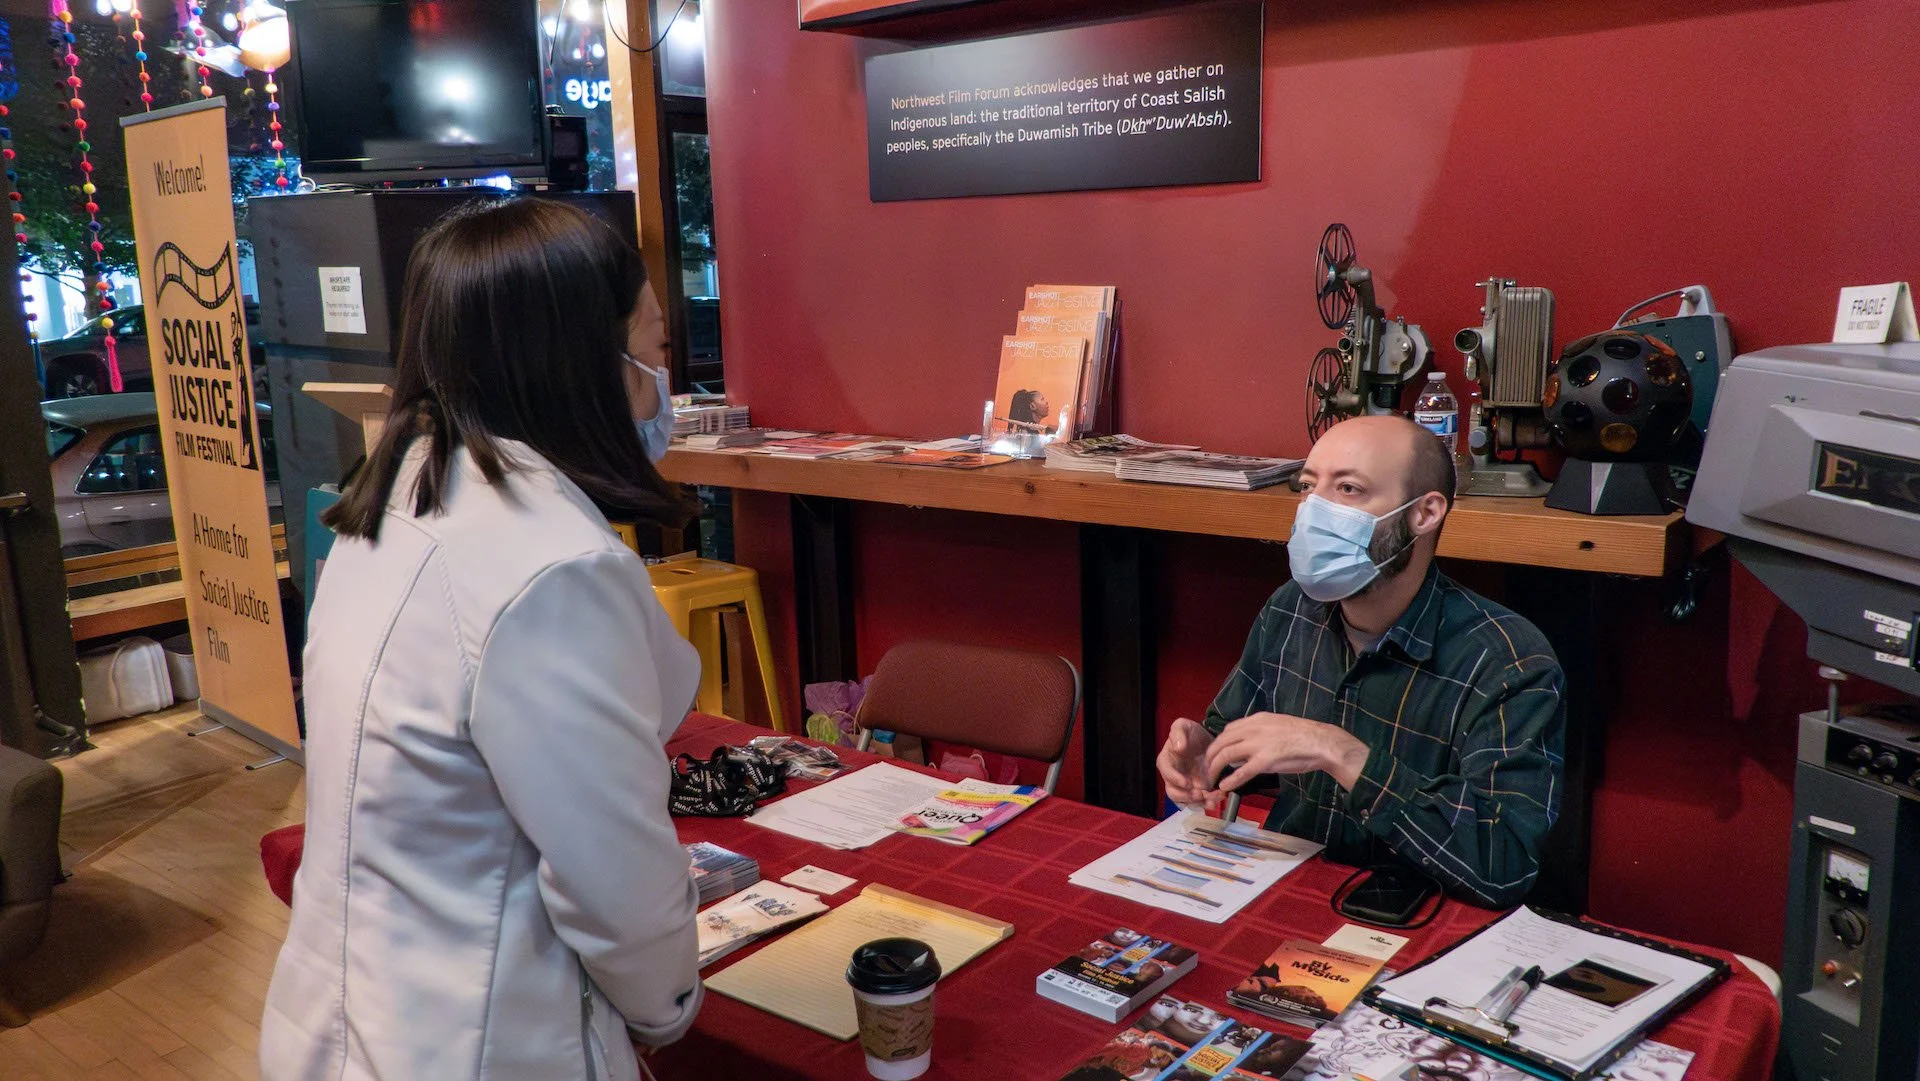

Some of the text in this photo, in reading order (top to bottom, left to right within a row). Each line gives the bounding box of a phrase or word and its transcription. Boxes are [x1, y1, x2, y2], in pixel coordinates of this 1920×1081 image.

[890, 85, 1225, 132] Indigenous land: the traditional territory of Coast Salish
[891, 63, 1224, 110] Northwest Film Forum acknowledges that we gather on
[886, 138, 930, 155] peoples,
[932, 132, 992, 150] specifically
[994, 130, 1014, 144] the
[1017, 123, 1079, 142] Duwamish
[1082, 121, 1113, 137] Tribe
[153, 153, 207, 196] Welcome!
[1851, 296, 1887, 315] FRAGILE
[161, 317, 231, 371] SOCIAL
[169, 373, 237, 429] JUSTICE
[175, 431, 238, 467] FILM FESTIVAL
[193, 512, 249, 560] A Home for
[200, 569, 270, 625] Social Justice
[207, 626, 231, 664] Film
[913, 809, 984, 825] Queer
